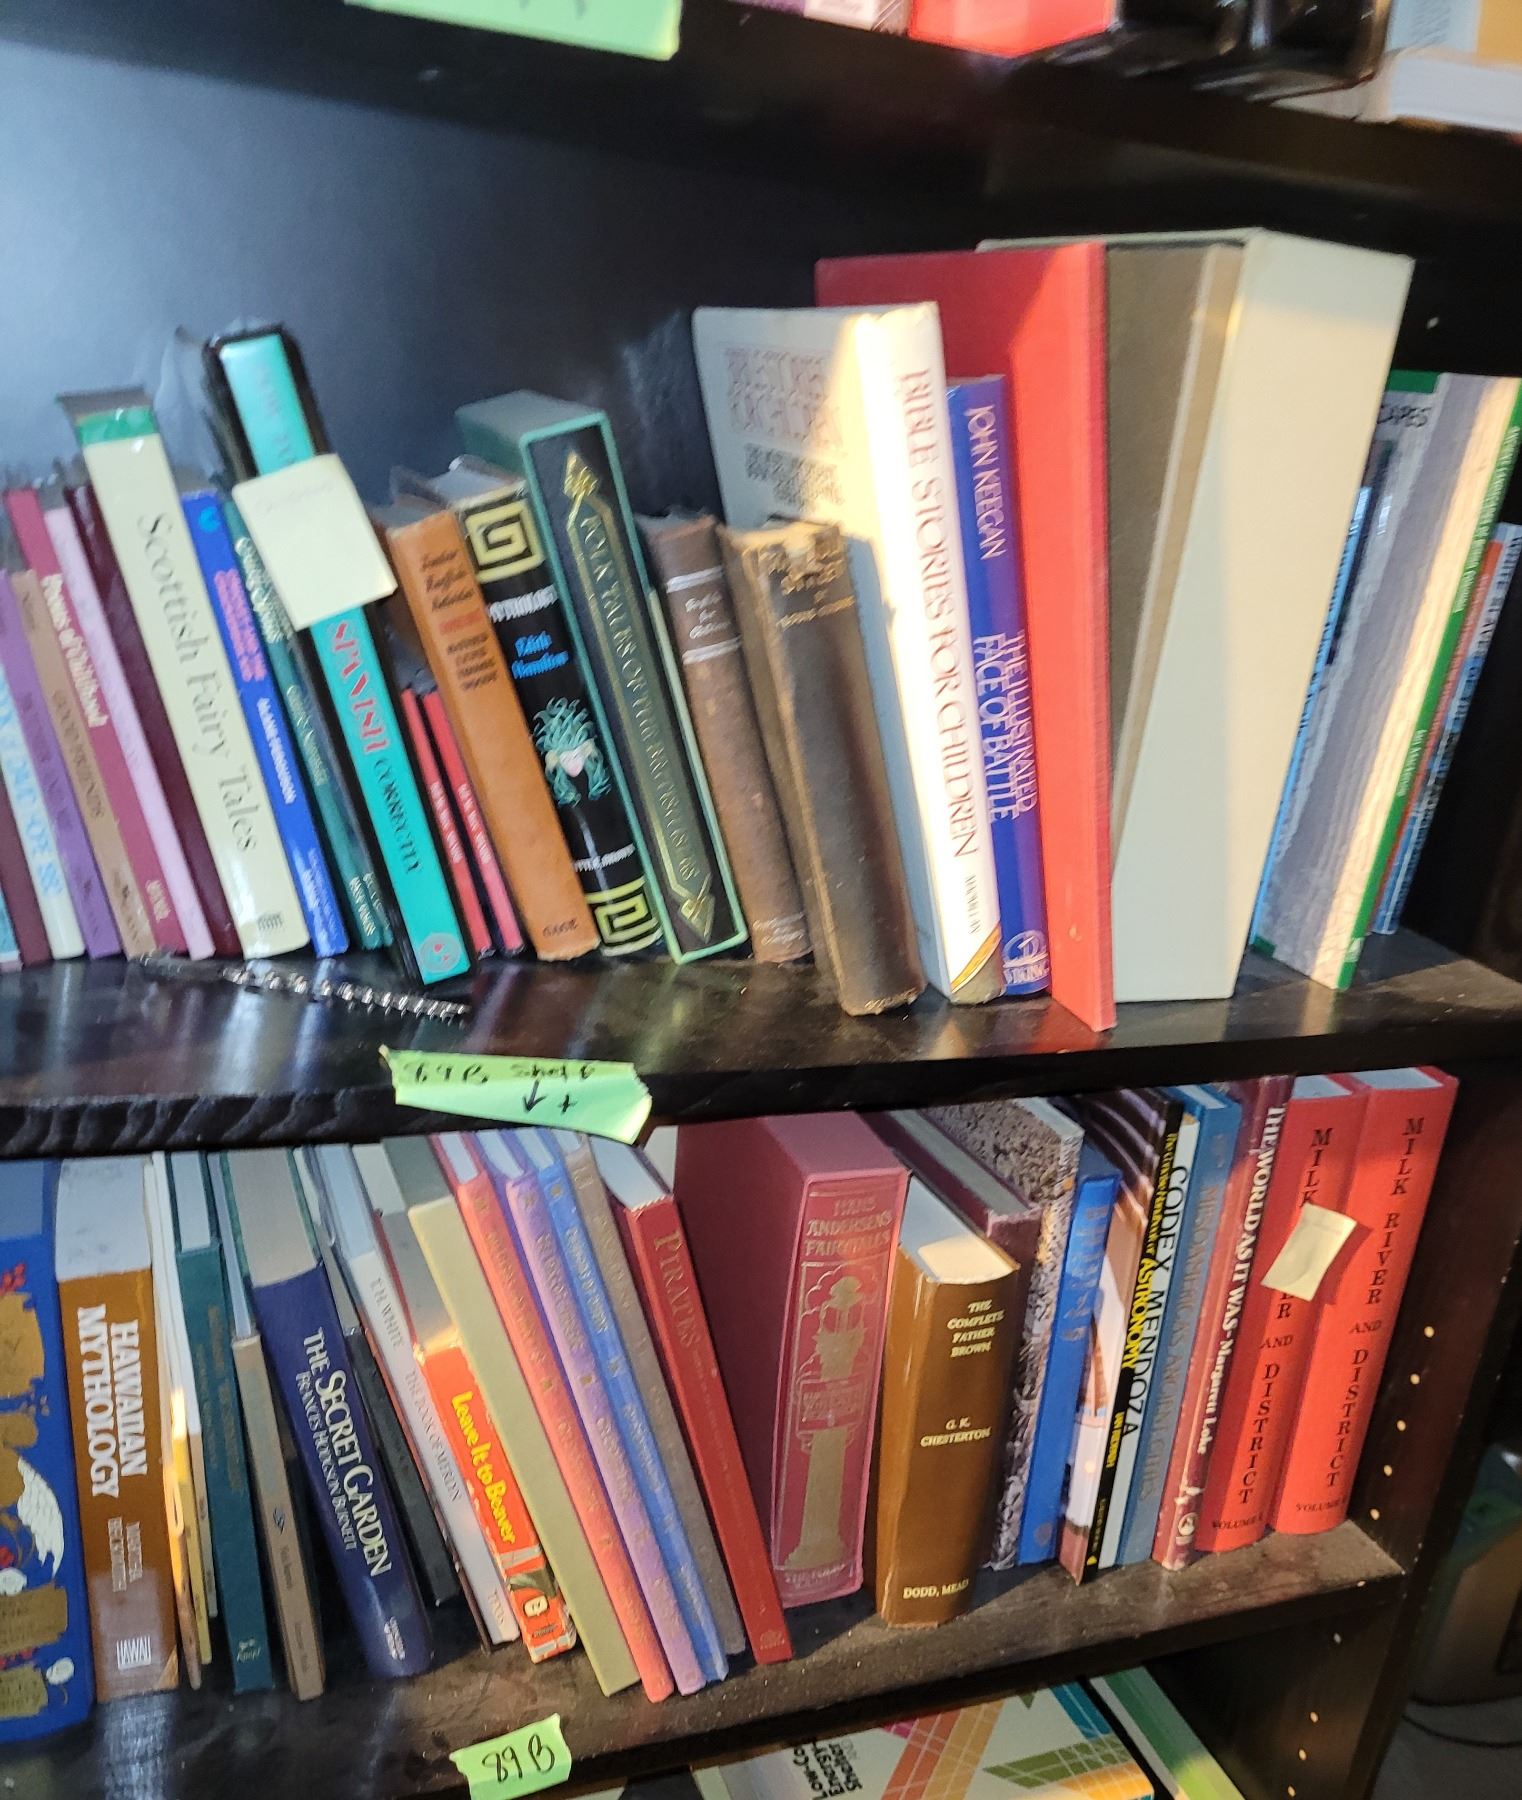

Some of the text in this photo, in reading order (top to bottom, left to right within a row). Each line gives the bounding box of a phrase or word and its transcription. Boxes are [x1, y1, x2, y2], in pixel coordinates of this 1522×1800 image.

[964, 404, 1007, 560] JOHN KEEGAN
[898, 369, 979, 858] BIBLE STORIES FOR CHILDREN
[137, 512, 258, 852] Scottish Fairy Tales
[973, 632, 1020, 823] FACE OF BATTLE
[327, 620, 425, 875] SPANISH CORRECTLY
[1006, 676, 1037, 814] ILLUSTRATED
[1260, 1106, 1288, 1150] THE
[1299, 1128, 1333, 1206] MILK
[1243, 1148, 1276, 1231] WORLD
[654, 1230, 700, 1348] PIRATES
[1122, 1165, 1189, 1438] CODEX MENDOZA
[1231, 1260, 1250, 1283] IT
[1236, 1233, 1256, 1262] AS
[1325, 1117, 1425, 1488] MILK RIVER AND DISTRICT
[379, 1308, 404, 1348] WHITE
[946, 1309, 1006, 1331] COMPLETE
[950, 1340, 993, 1359] BROWN
[951, 1326, 996, 1344] FATHER
[967, 1299, 993, 1315] THE
[1121, 1258, 1155, 1370] ASTRONOMY
[1259, 1333, 1294, 1350] AND
[77, 1303, 121, 1500] MYTHOLOGY
[111, 1319, 149, 1478] HAWAIIAN
[302, 1326, 393, 1578] THE SECRET GARDEN
[920, 1427, 992, 1449] CHESTERTON
[1238, 1362, 1281, 1505] DISTRICT
[295, 1369, 358, 1552] FRANCES HODGSON BURNETT
[451, 1390, 516, 1546] Leave It to Beaver
[1211, 1514, 1257, 1530] VOLUME
[902, 1578, 970, 1600] DODD, MEAD
